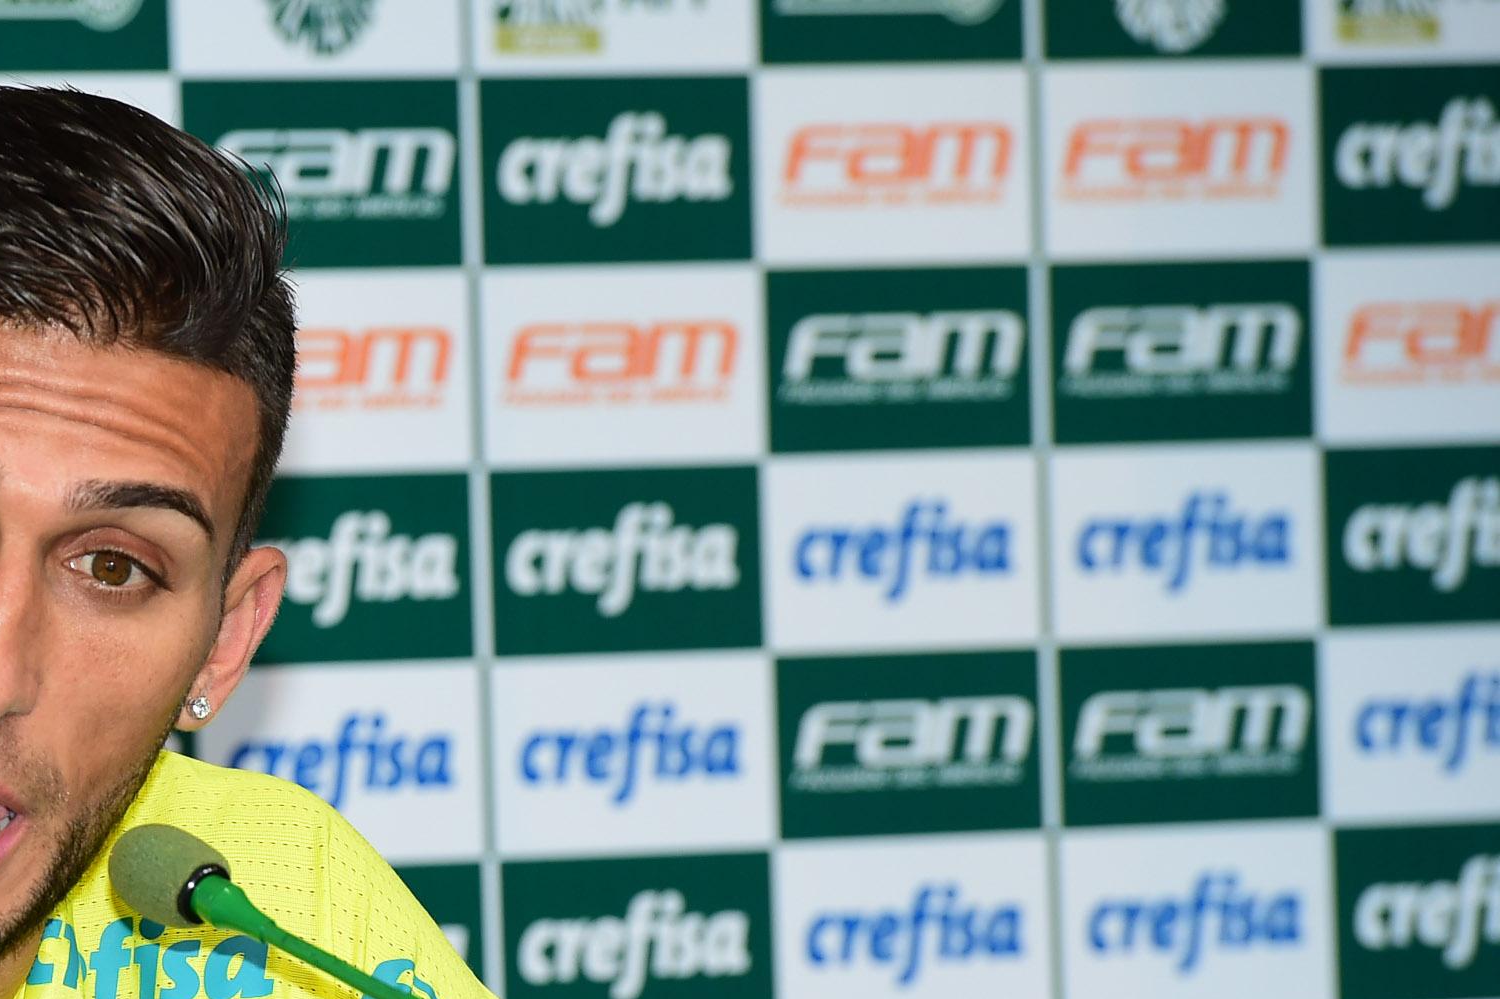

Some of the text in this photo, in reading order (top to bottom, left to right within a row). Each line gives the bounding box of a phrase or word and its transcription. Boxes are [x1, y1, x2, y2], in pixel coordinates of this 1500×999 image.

[498, 112, 731, 226] crefisa
[293, 327, 454, 386] am
[506, 503, 739, 616] crefisa
[793, 501, 1013, 602] crefisa
[1076, 492, 1293, 593] crefisa
[518, 703, 741, 806] crefisa
[805, 885, 1024, 986] crefisa
[1087, 873, 1304, 973] crefisa
